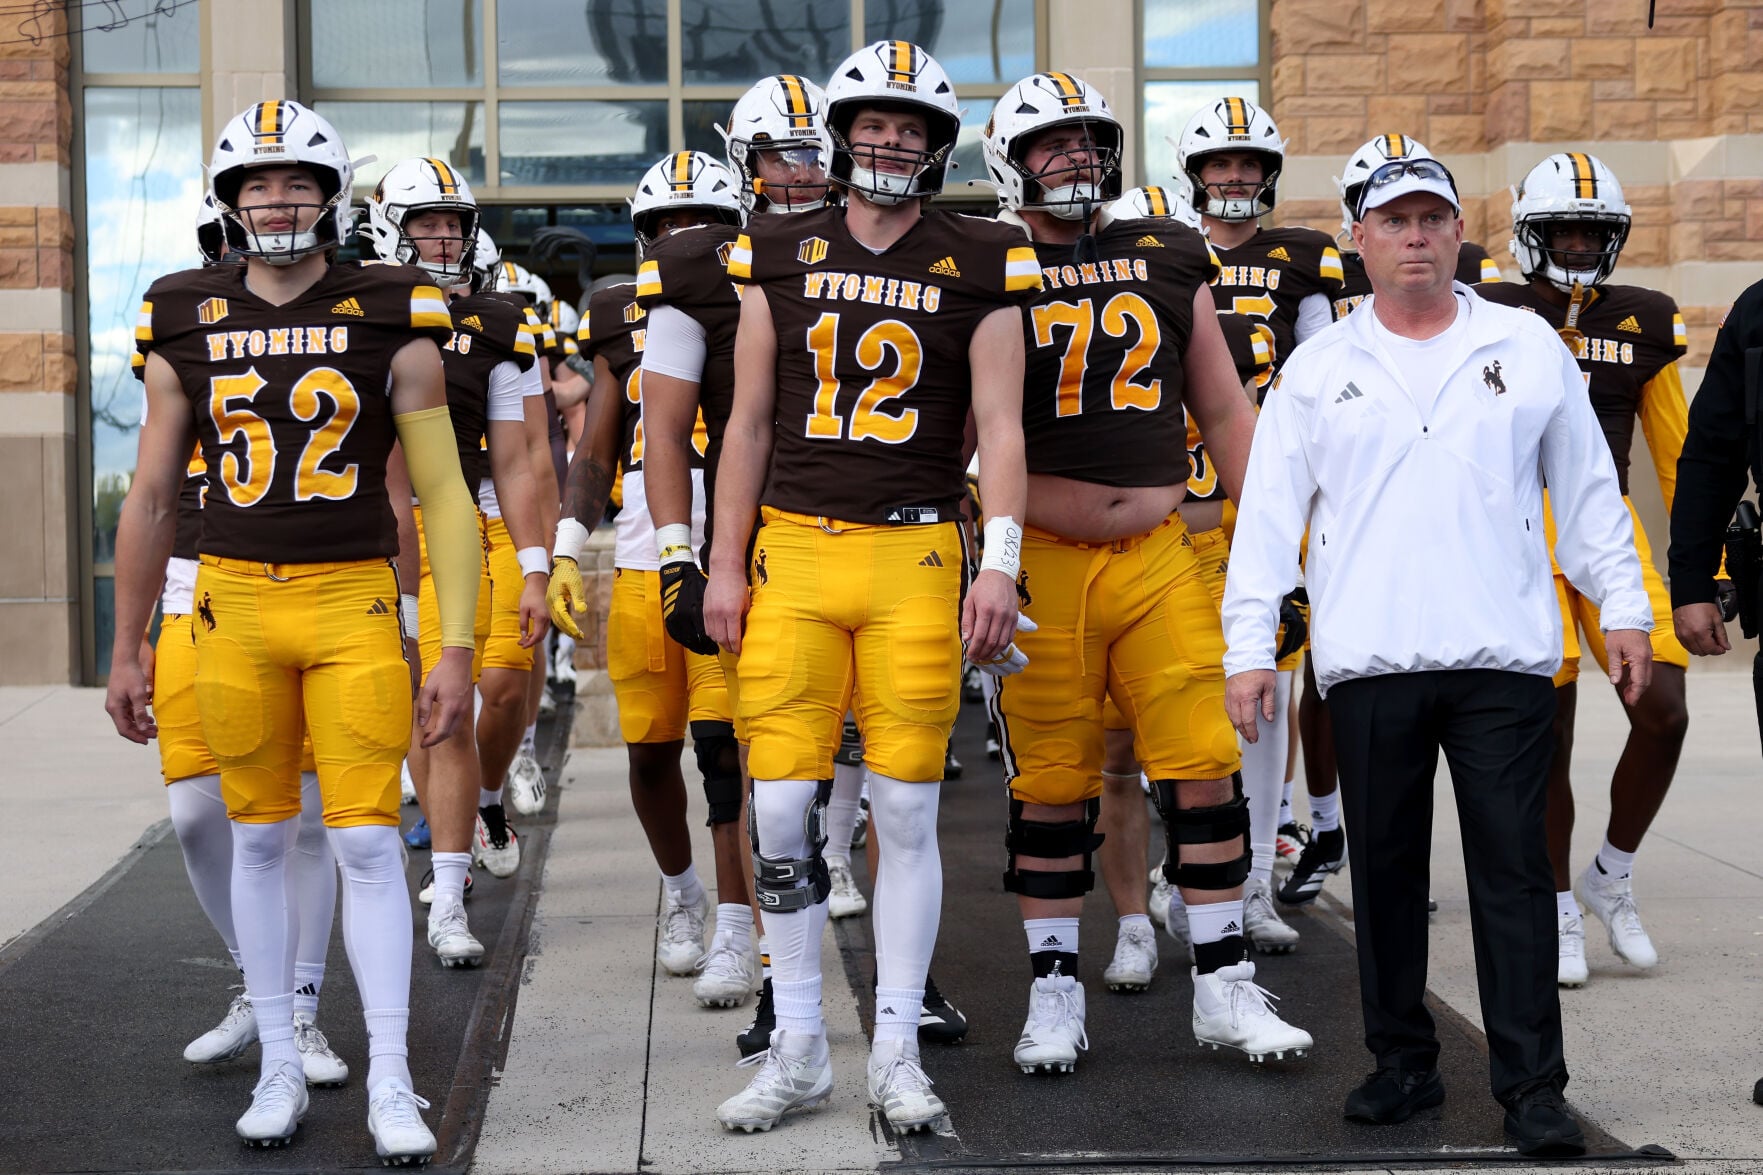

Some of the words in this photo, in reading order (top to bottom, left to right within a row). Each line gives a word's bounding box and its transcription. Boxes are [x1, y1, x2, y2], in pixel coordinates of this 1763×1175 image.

[885, 81, 917, 94] WYOMING
[1063, 105, 1091, 115] WYOMING
[789, 129, 817, 138] WYOMING
[253, 145, 286, 156] WYOMING
[1040, 258, 1148, 293] YOMING
[1210, 266, 1281, 291] MING
[804, 271, 942, 313] WYOMING
[207, 326, 348, 362] WYOMING
[1030, 291, 1162, 418] 72
[1574, 337, 1634, 365] MING
[805, 312, 924, 444] 12
[209, 366, 361, 508] 52
